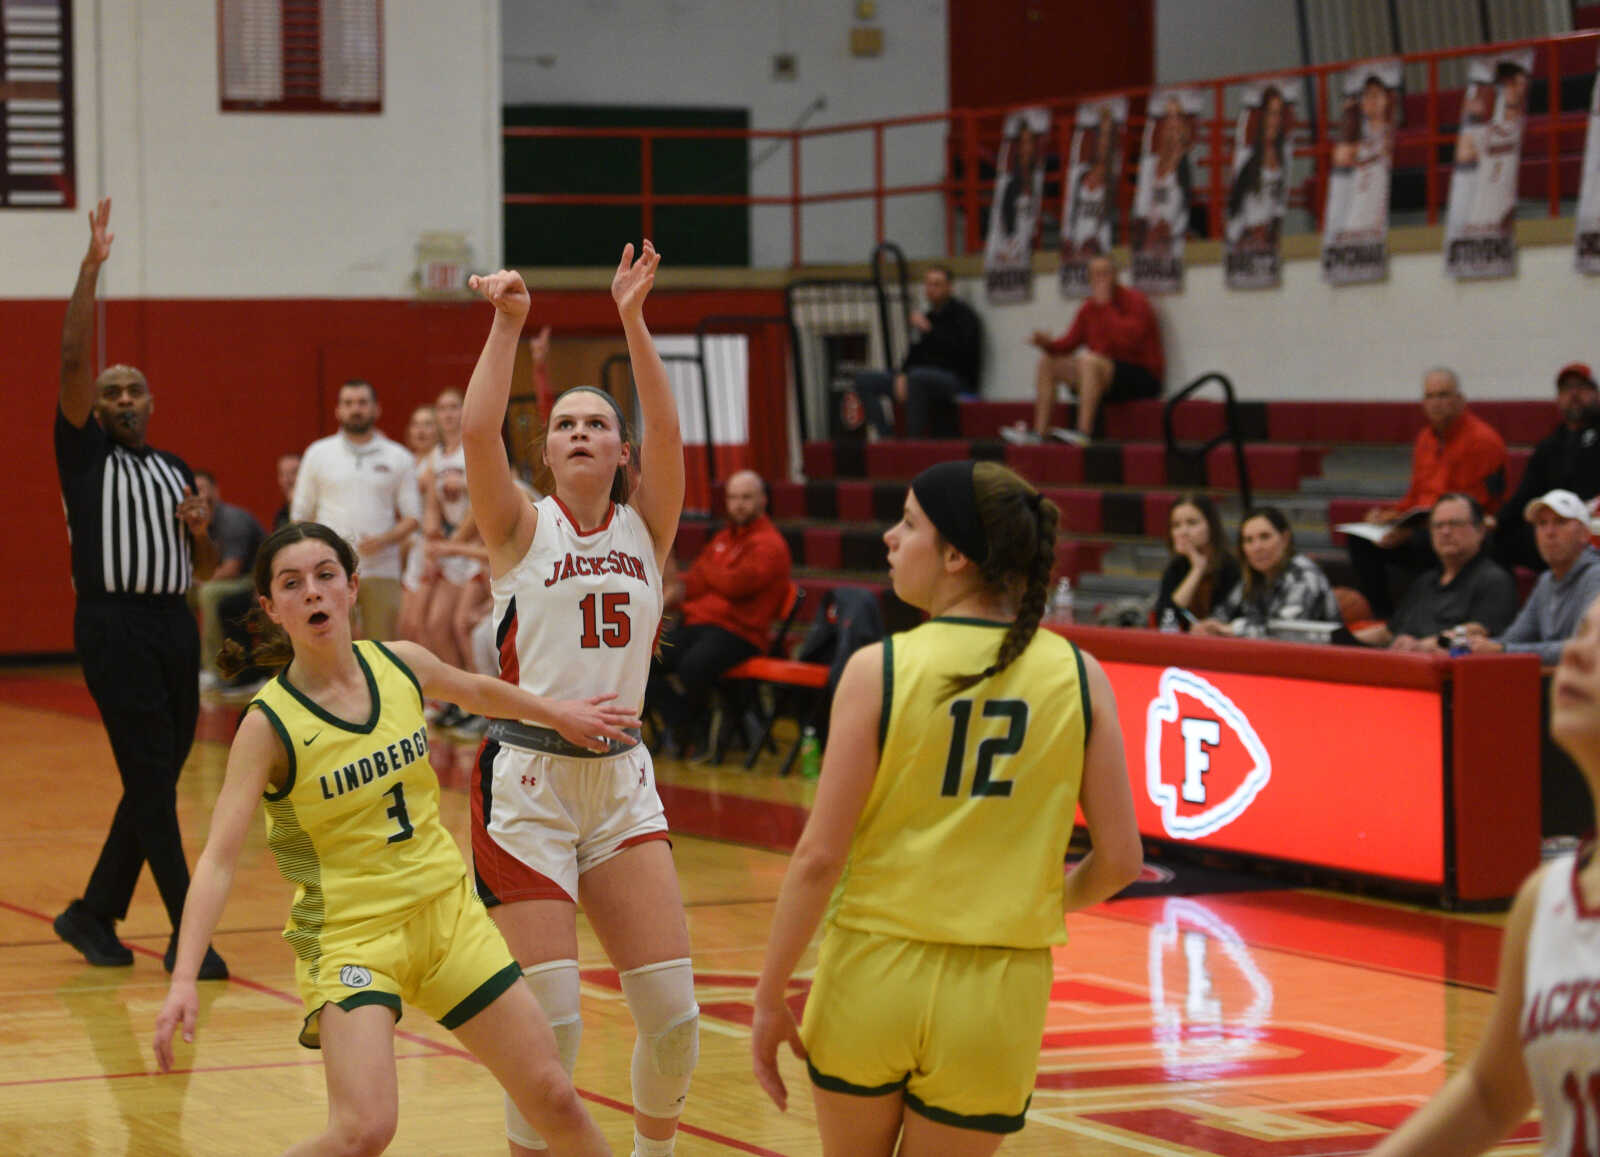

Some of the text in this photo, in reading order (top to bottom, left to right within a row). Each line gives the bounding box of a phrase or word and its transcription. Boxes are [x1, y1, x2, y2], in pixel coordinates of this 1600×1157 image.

[544, 549, 649, 588] JACKSON
[579, 592, 631, 649] 15
[940, 698, 1029, 798] 12
[1181, 716, 1221, 804] F
[382, 781, 414, 846] 3
